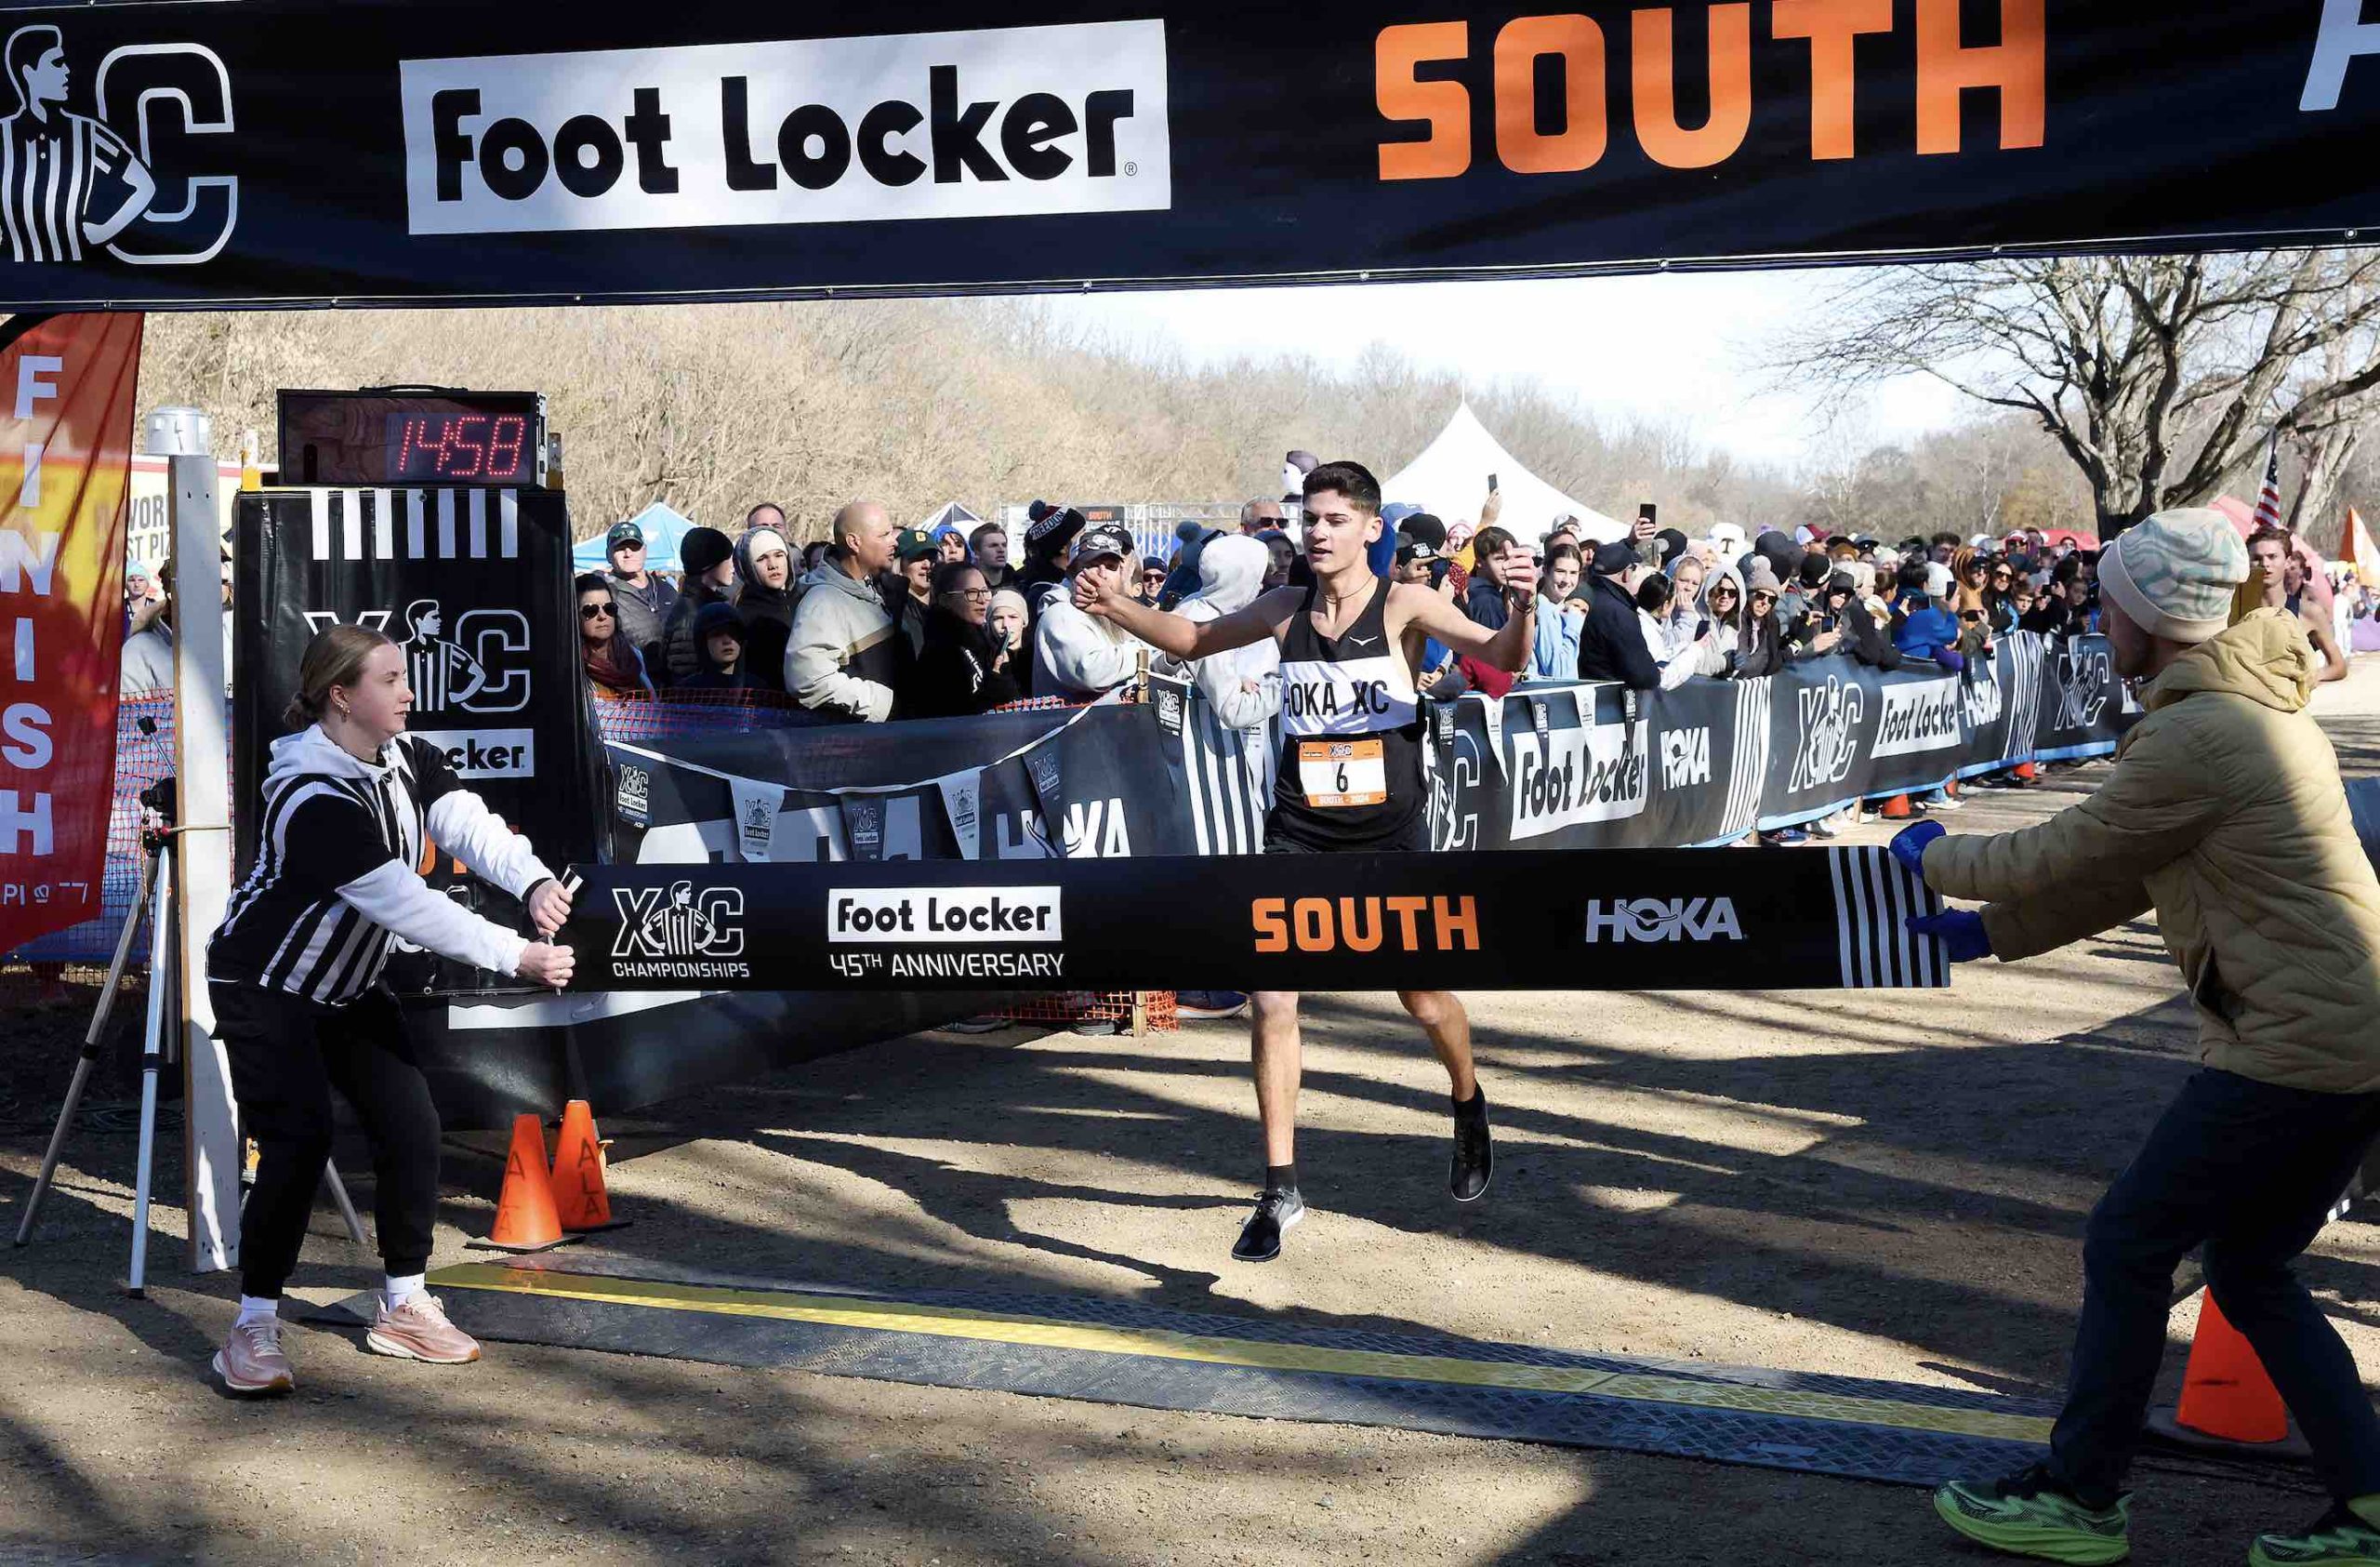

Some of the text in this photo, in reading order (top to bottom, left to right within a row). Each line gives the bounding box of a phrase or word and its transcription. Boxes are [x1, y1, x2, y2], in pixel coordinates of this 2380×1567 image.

[1376, 0, 2047, 180] SOUTH
[431, 65, 1134, 202] Foot Locker
[399, 417, 524, 475] 14:58
[1351, 680, 1389, 714] XC
[1880, 689, 1958, 744] Foot Locke
[444, 739, 524, 770] cker
[1336, 763, 1349, 793] 6
[1659, 726, 1712, 791] HOKA
[1520, 750, 1573, 819] Foot
[611, 887, 744, 956] XC
[838, 896, 1051, 932] Foot Locker
[1252, 896, 1480, 952] SOUTH
[1586, 897, 1743, 942] HOKA
[612, 962, 750, 977] CHAMPIONSHIPS
[892, 953, 1064, 976] ANNIVERSARY
